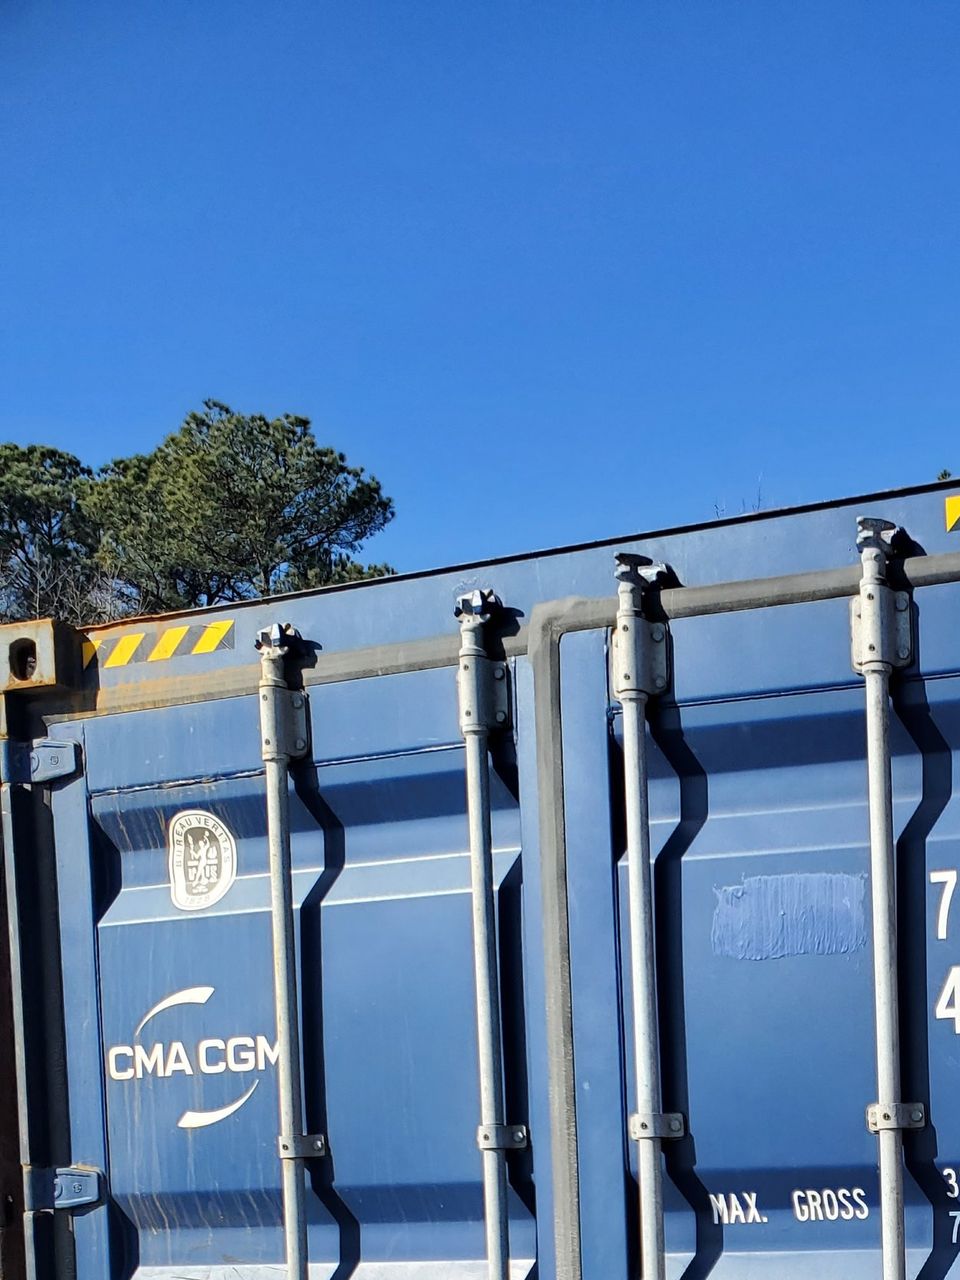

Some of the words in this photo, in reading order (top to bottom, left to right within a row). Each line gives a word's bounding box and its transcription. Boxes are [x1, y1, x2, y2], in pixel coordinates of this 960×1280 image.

[176, 817, 193, 867] BUREAU
[195, 816, 230, 863] VERITAS
[108, 1041, 194, 1080] CMA
[199, 1035, 279, 1074] CGM
[710, 1192, 768, 1224] MAX.
[793, 1188, 869, 1222] GROSS
